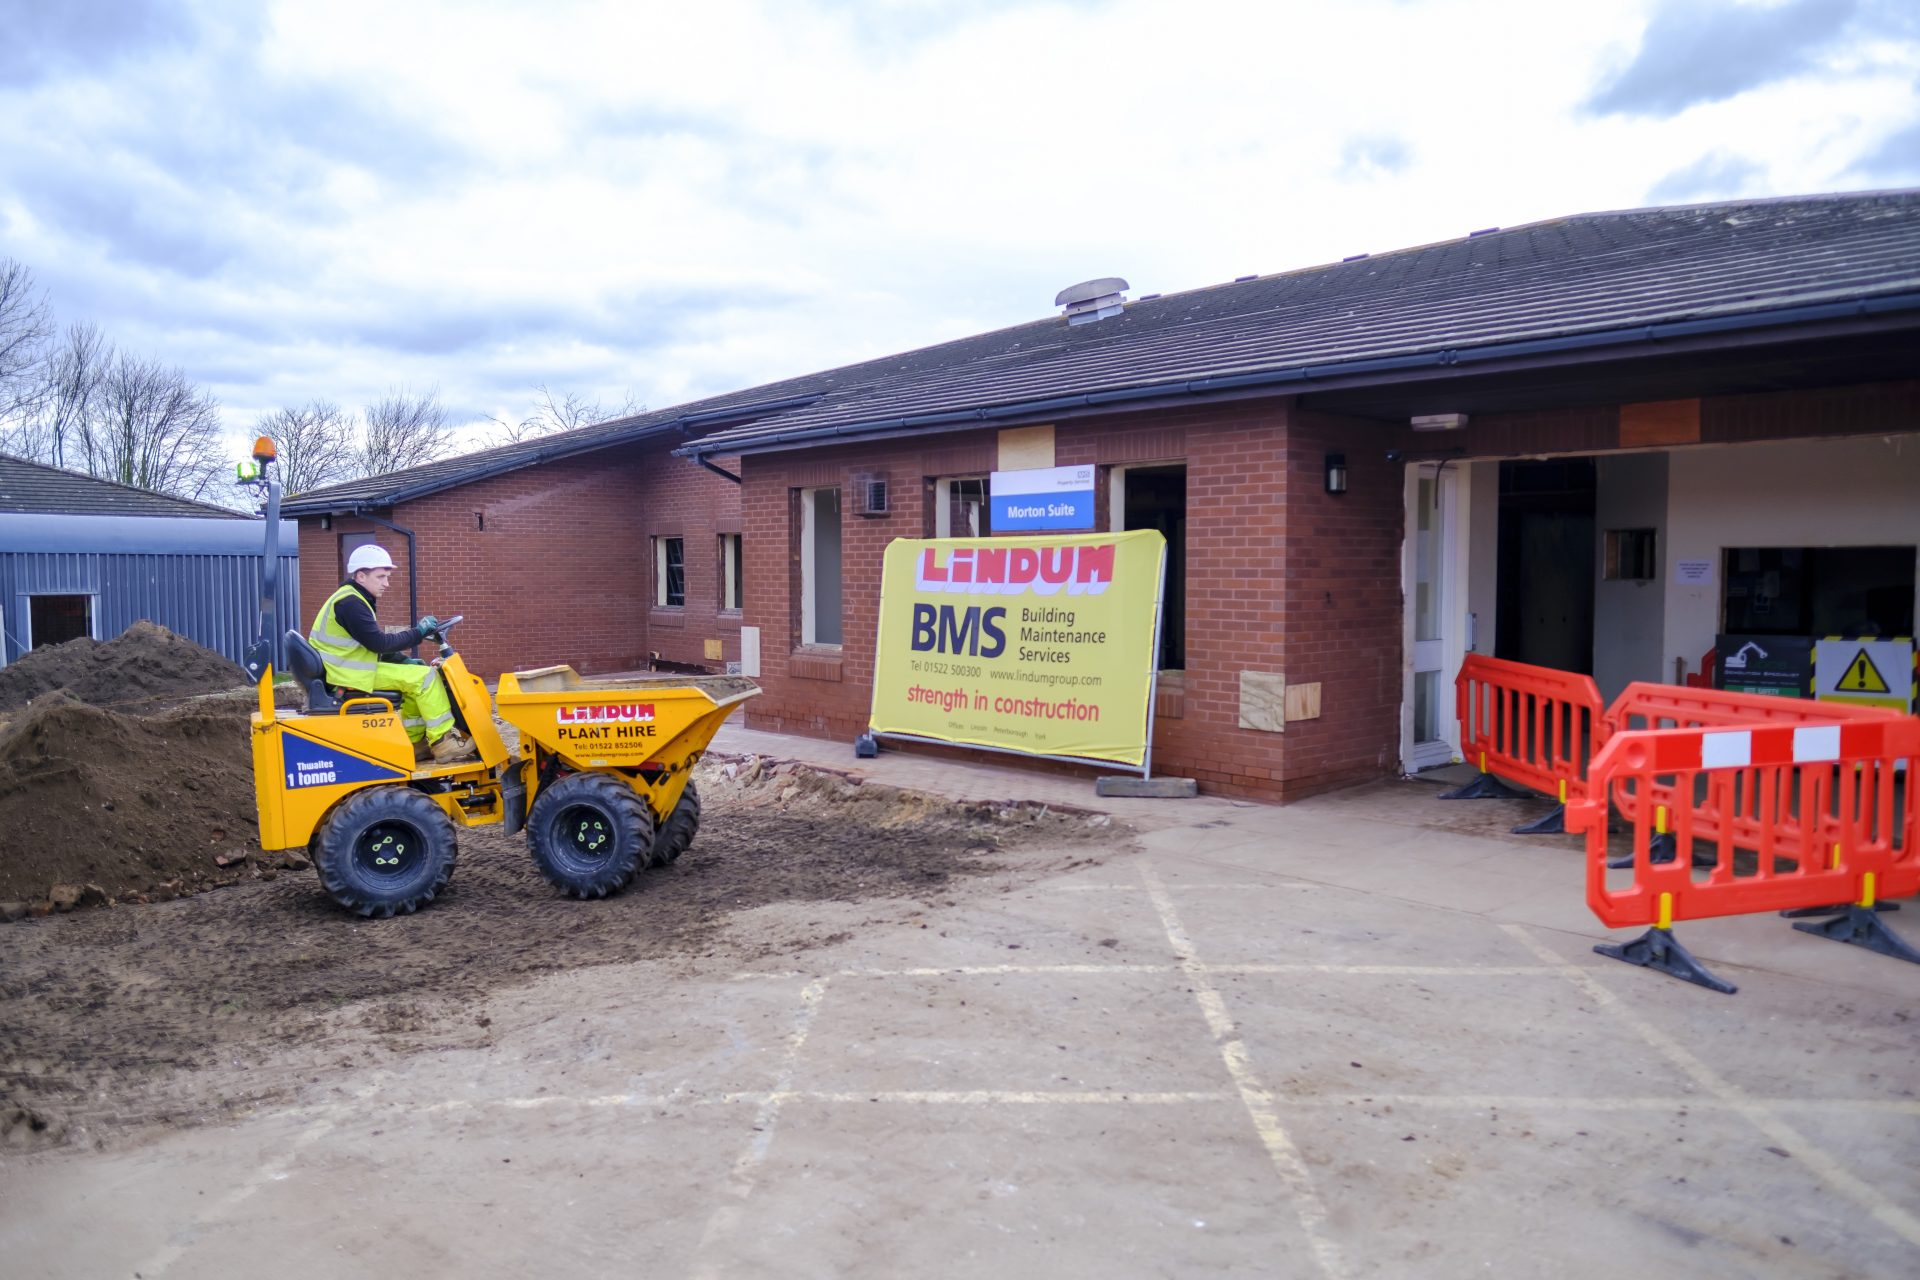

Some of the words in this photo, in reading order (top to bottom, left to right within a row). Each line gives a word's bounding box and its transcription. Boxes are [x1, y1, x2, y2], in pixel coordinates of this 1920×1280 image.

[1007, 505, 1045, 518] Morton
[1048, 502, 1075, 517] Suite
[1022, 608, 1075, 627] Building
[911, 602, 1007, 659] BMS
[1020, 627, 1106, 644] Maintenance
[1019, 647, 1070, 663] Services
[911, 660, 921, 671] Tel
[924, 661, 948, 675] 01522
[951, 664, 981, 678] 500300
[990, 669, 1102, 687] www.lindumgroup.com
[907, 684, 968, 712] strength
[974, 690, 988, 711] in
[994, 697, 1100, 722] construction
[362, 718, 394, 729] 5027
[558, 727, 610, 739] PLANT
[617, 725, 656, 738] HIRE
[615, 741, 643, 749] 852506
[297, 760, 333, 771] Thwaites
[287, 773, 295, 786] 1
[298, 770, 336, 785] tonne
